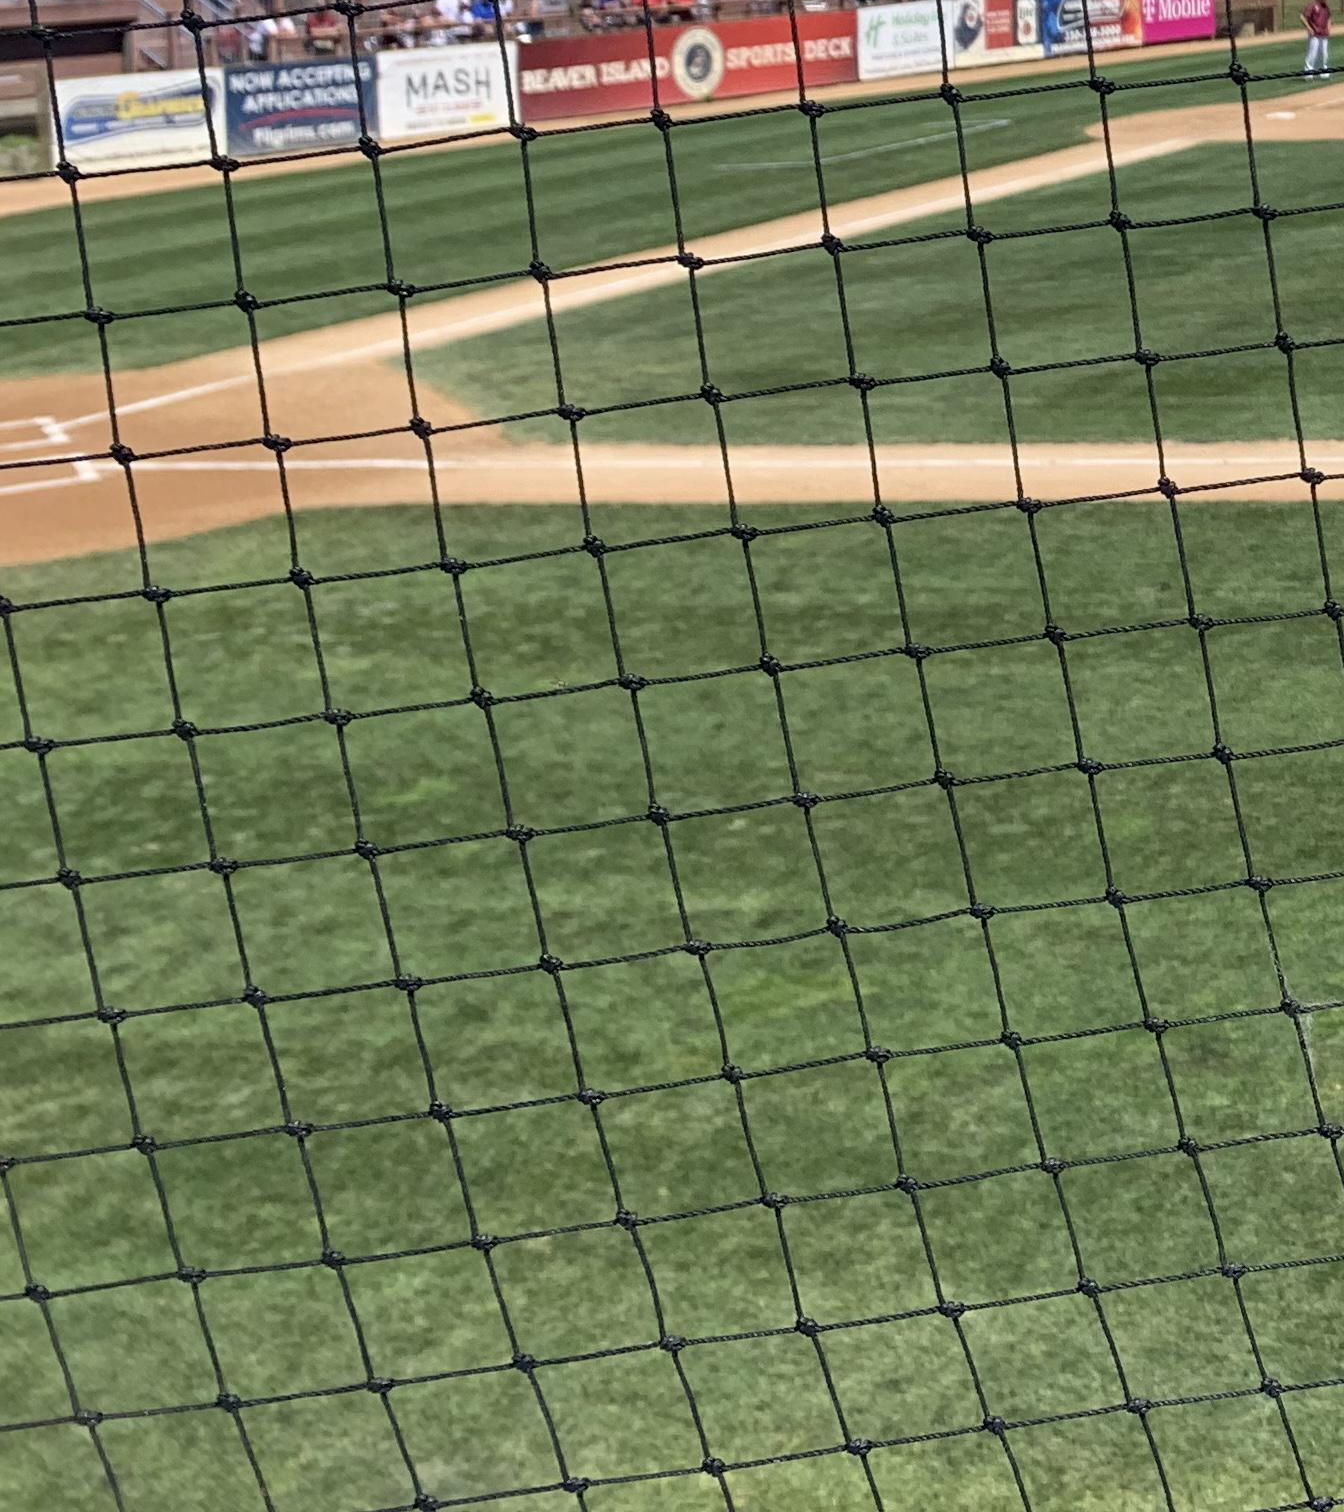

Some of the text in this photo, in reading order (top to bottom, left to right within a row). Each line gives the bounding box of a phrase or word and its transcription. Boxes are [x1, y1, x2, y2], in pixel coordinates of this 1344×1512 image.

[725, 40, 797, 70] SPORTS
[802, 36, 853, 61] DECK
[228, 69, 275, 94] NOW
[405, 65, 491, 108] MASH
[521, 61, 599, 94] BEAVER
[599, 55, 671, 86] ISLAND
